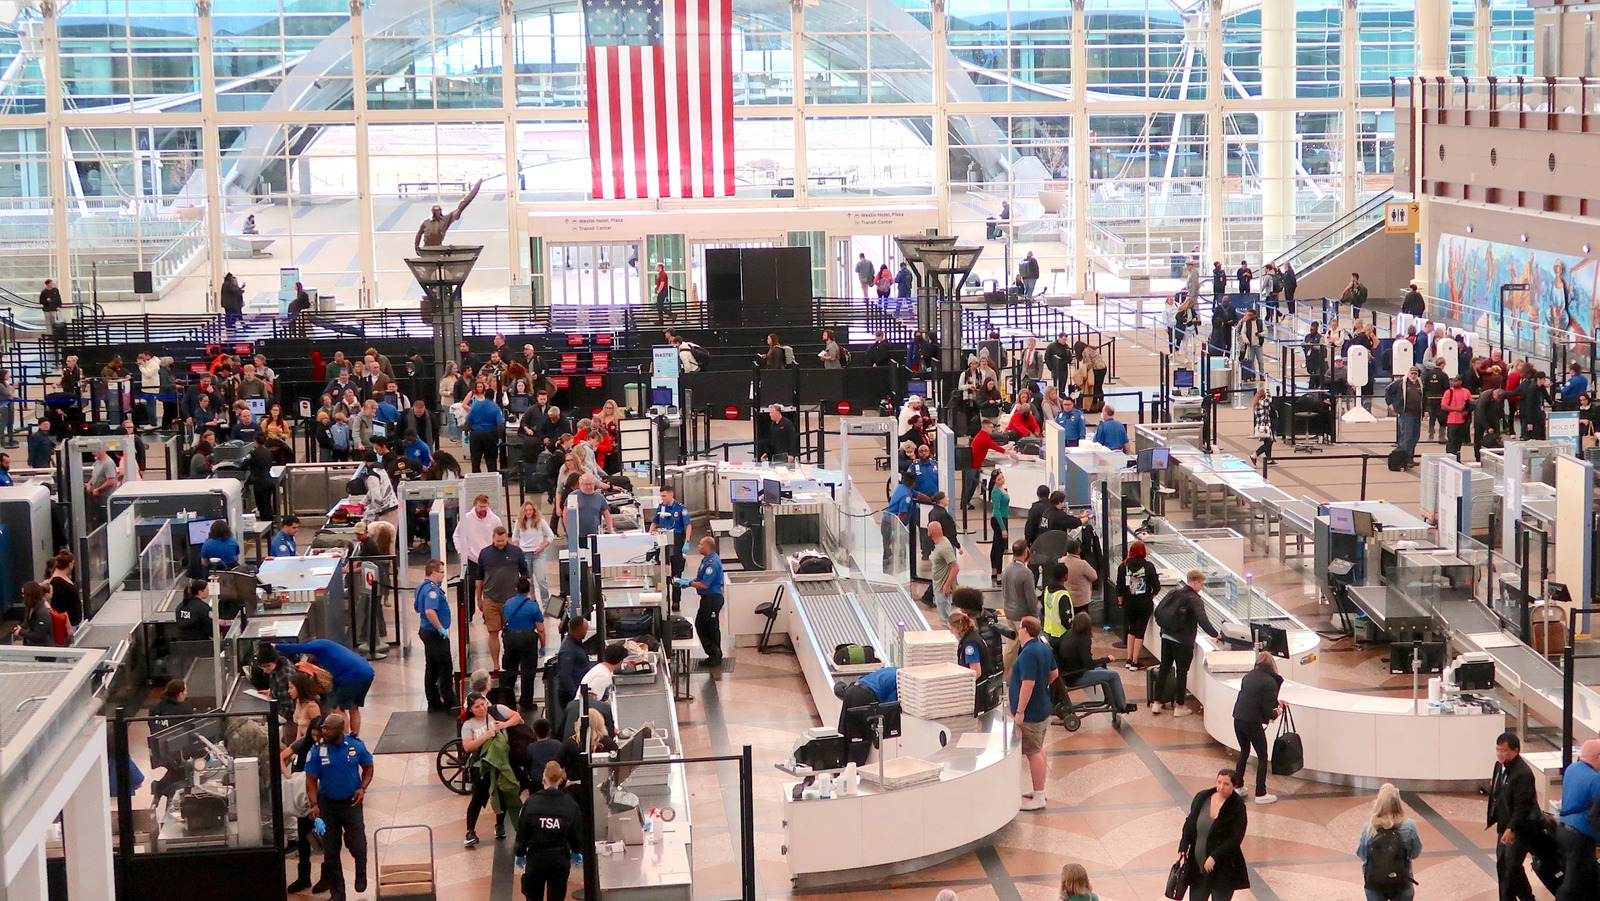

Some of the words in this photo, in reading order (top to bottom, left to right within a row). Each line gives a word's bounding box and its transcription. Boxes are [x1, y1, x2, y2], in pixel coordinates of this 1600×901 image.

[878, 422, 889, 431] 10
[180, 610, 191, 619] TSA
[539, 817, 561, 829] TSA
